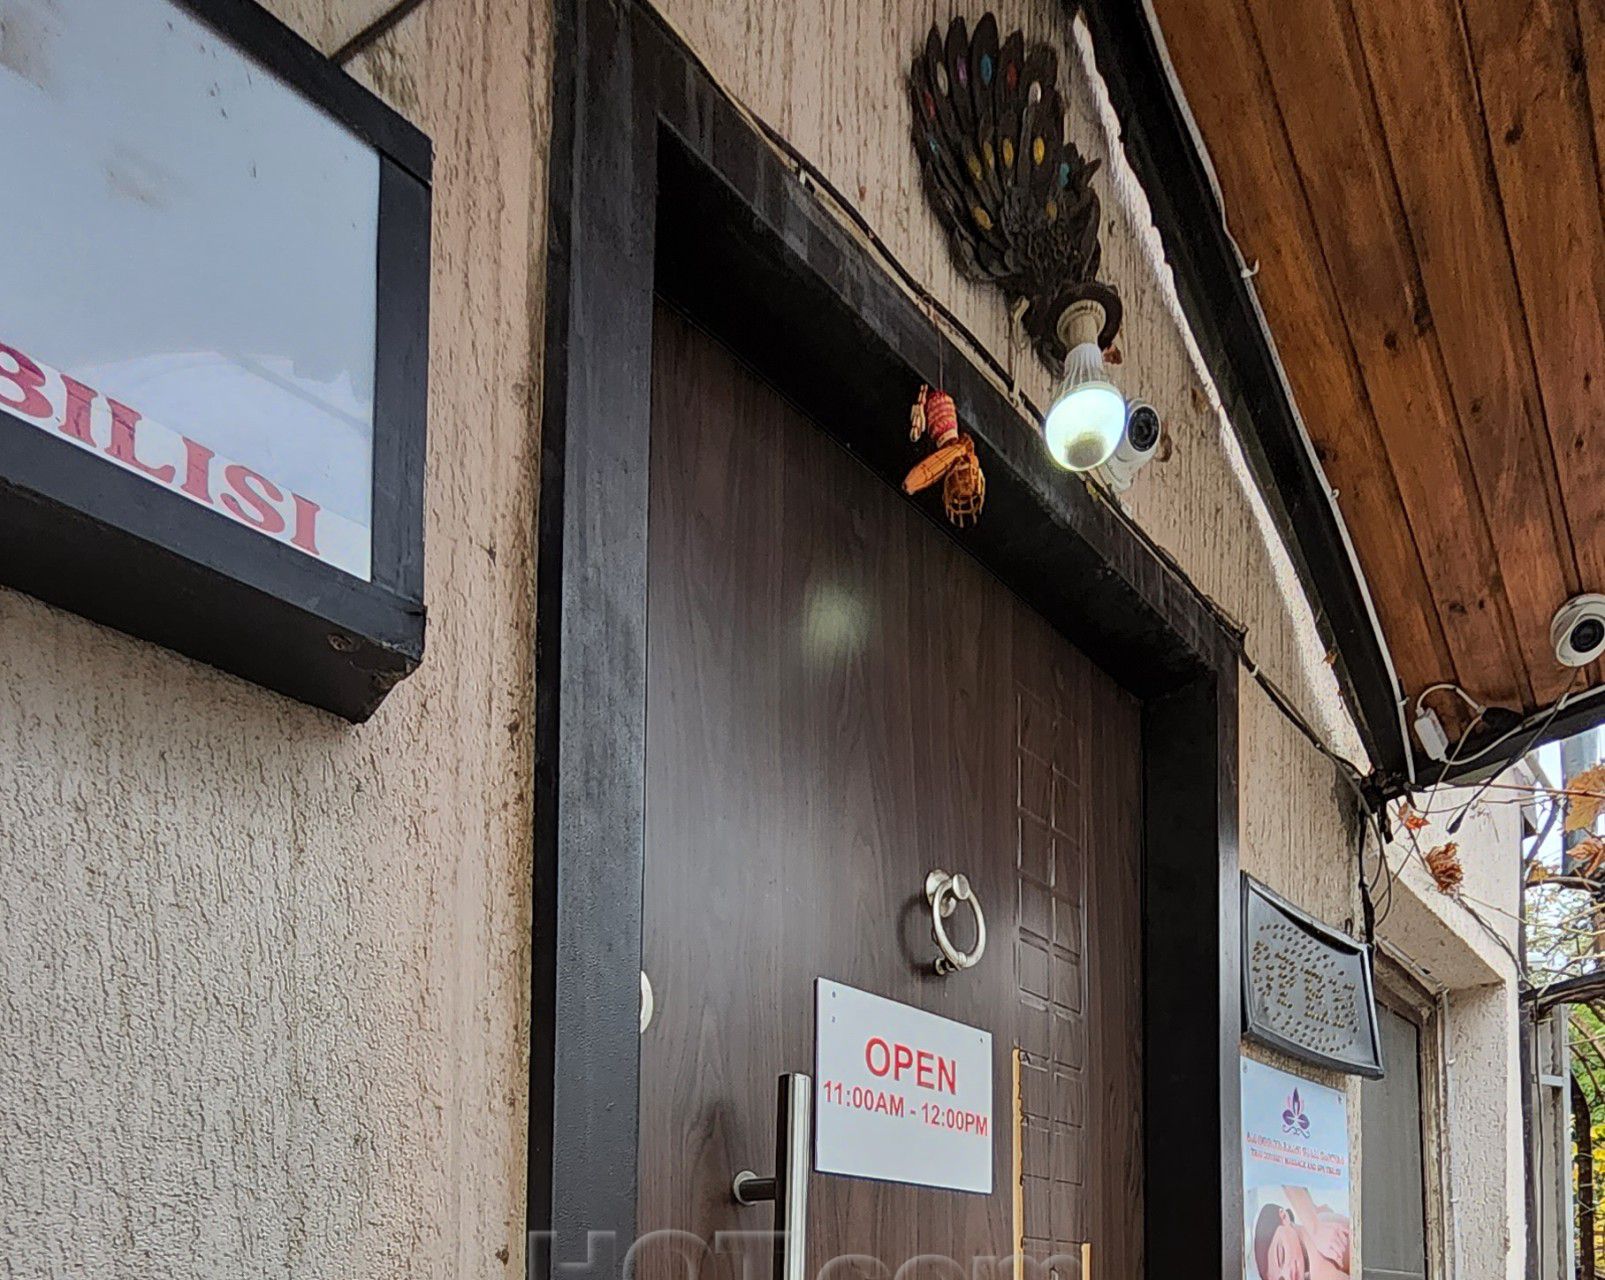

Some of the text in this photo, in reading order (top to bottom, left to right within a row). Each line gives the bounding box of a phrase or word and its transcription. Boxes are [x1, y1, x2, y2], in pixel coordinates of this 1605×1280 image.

[864, 1036, 957, 1095] OPEN
[823, 1080, 905, 1118] 11:00AM
[921, 1103, 988, 1136] 12:00PM
